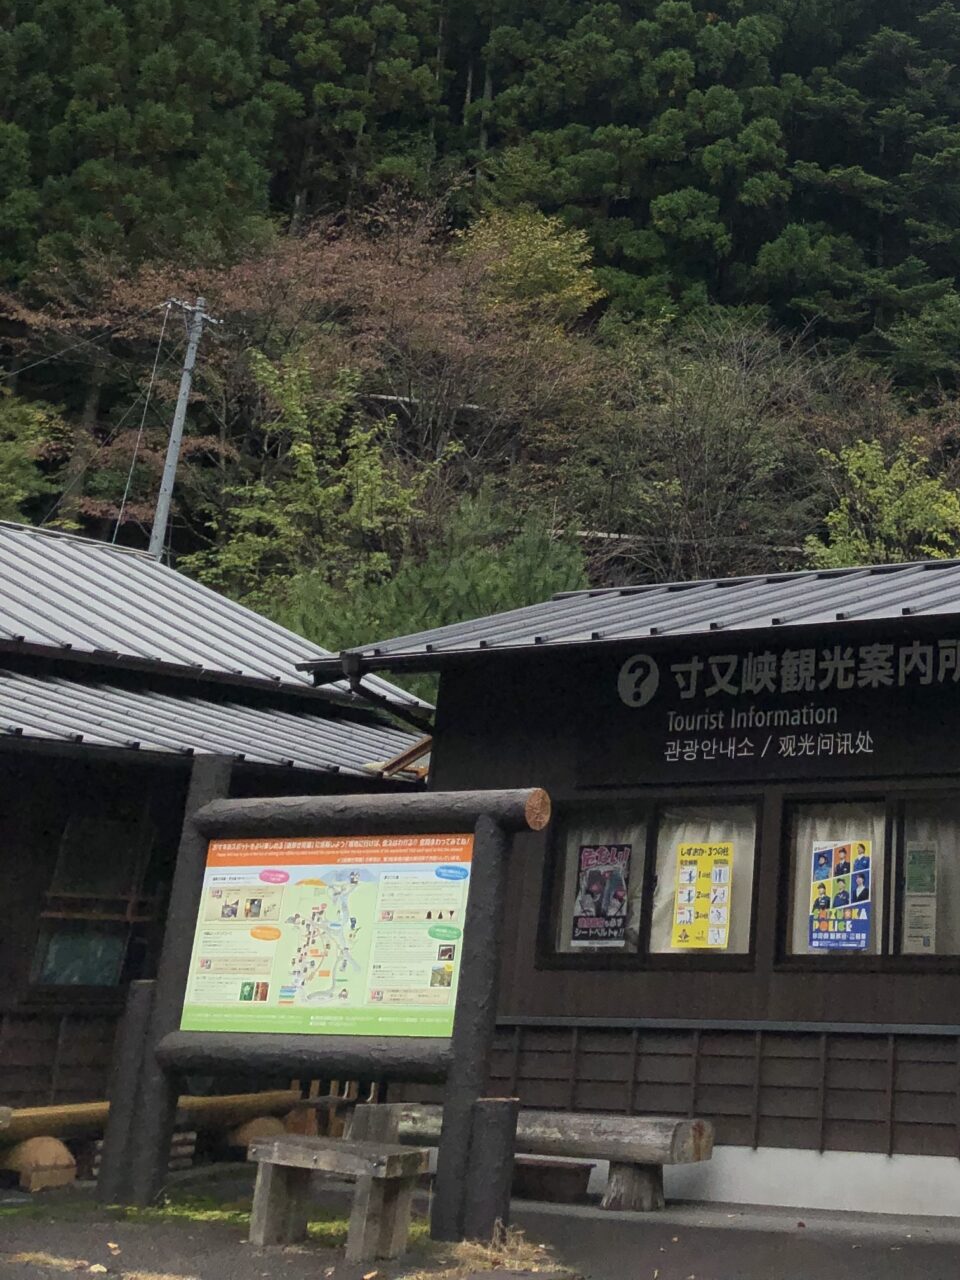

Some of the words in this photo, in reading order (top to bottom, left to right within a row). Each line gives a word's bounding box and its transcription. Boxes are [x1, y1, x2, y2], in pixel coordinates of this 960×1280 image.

[667, 708, 724, 732] Tourist
[731, 703, 838, 728] Information
[664, 736, 755, 762] 관광안내소
[777, 731, 874, 757] 观光问讯处
[813, 908, 868, 920] SHIZUOKA
[812, 920, 854, 932] POLICE
